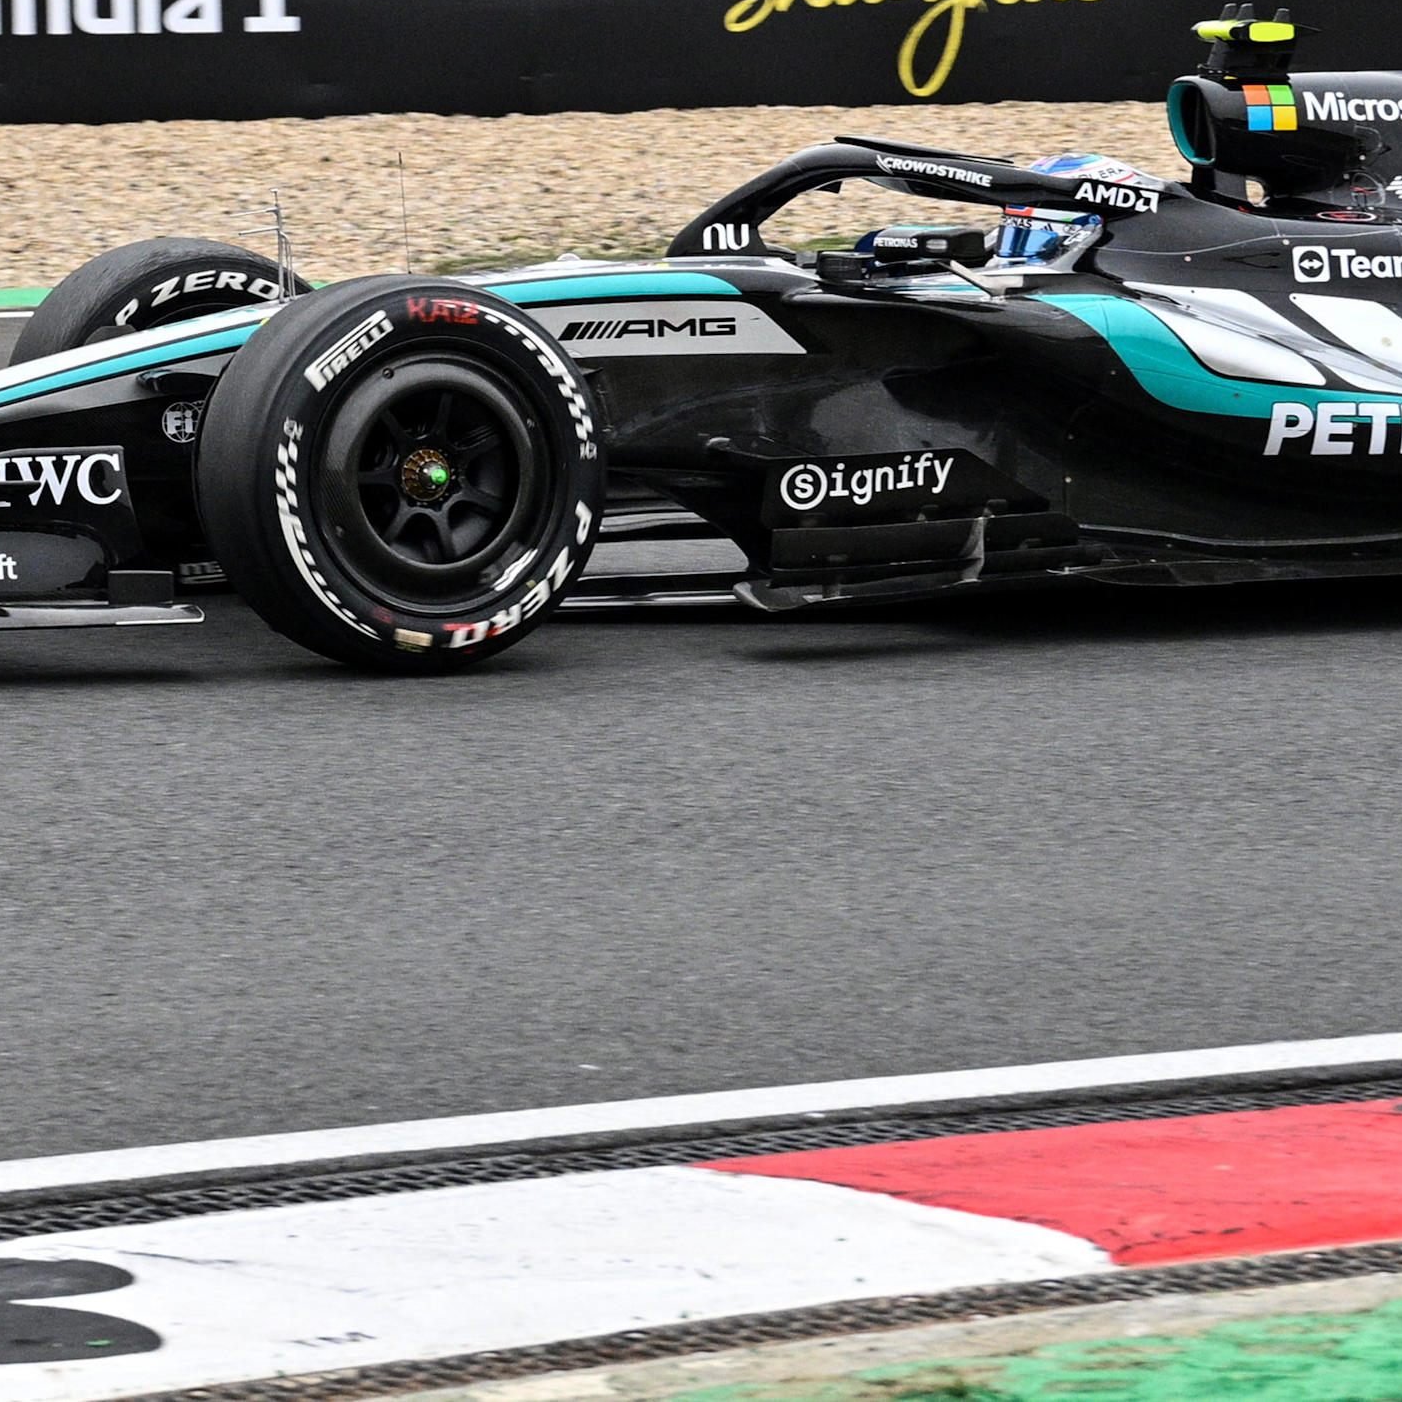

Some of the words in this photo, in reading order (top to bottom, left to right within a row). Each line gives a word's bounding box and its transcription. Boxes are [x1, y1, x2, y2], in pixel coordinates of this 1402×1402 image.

[883, 155, 994, 188] CROWDSTRIKE
[1074, 181, 1137, 210] AMD
[872, 236, 919, 250] PETRONAS
[150, 269, 282, 308] ZERO
[616, 317, 737, 338] AMG
[303, 309, 395, 393] PIRELLI
[574, 499, 593, 545] P
[449, 546, 576, 648] ZERO
